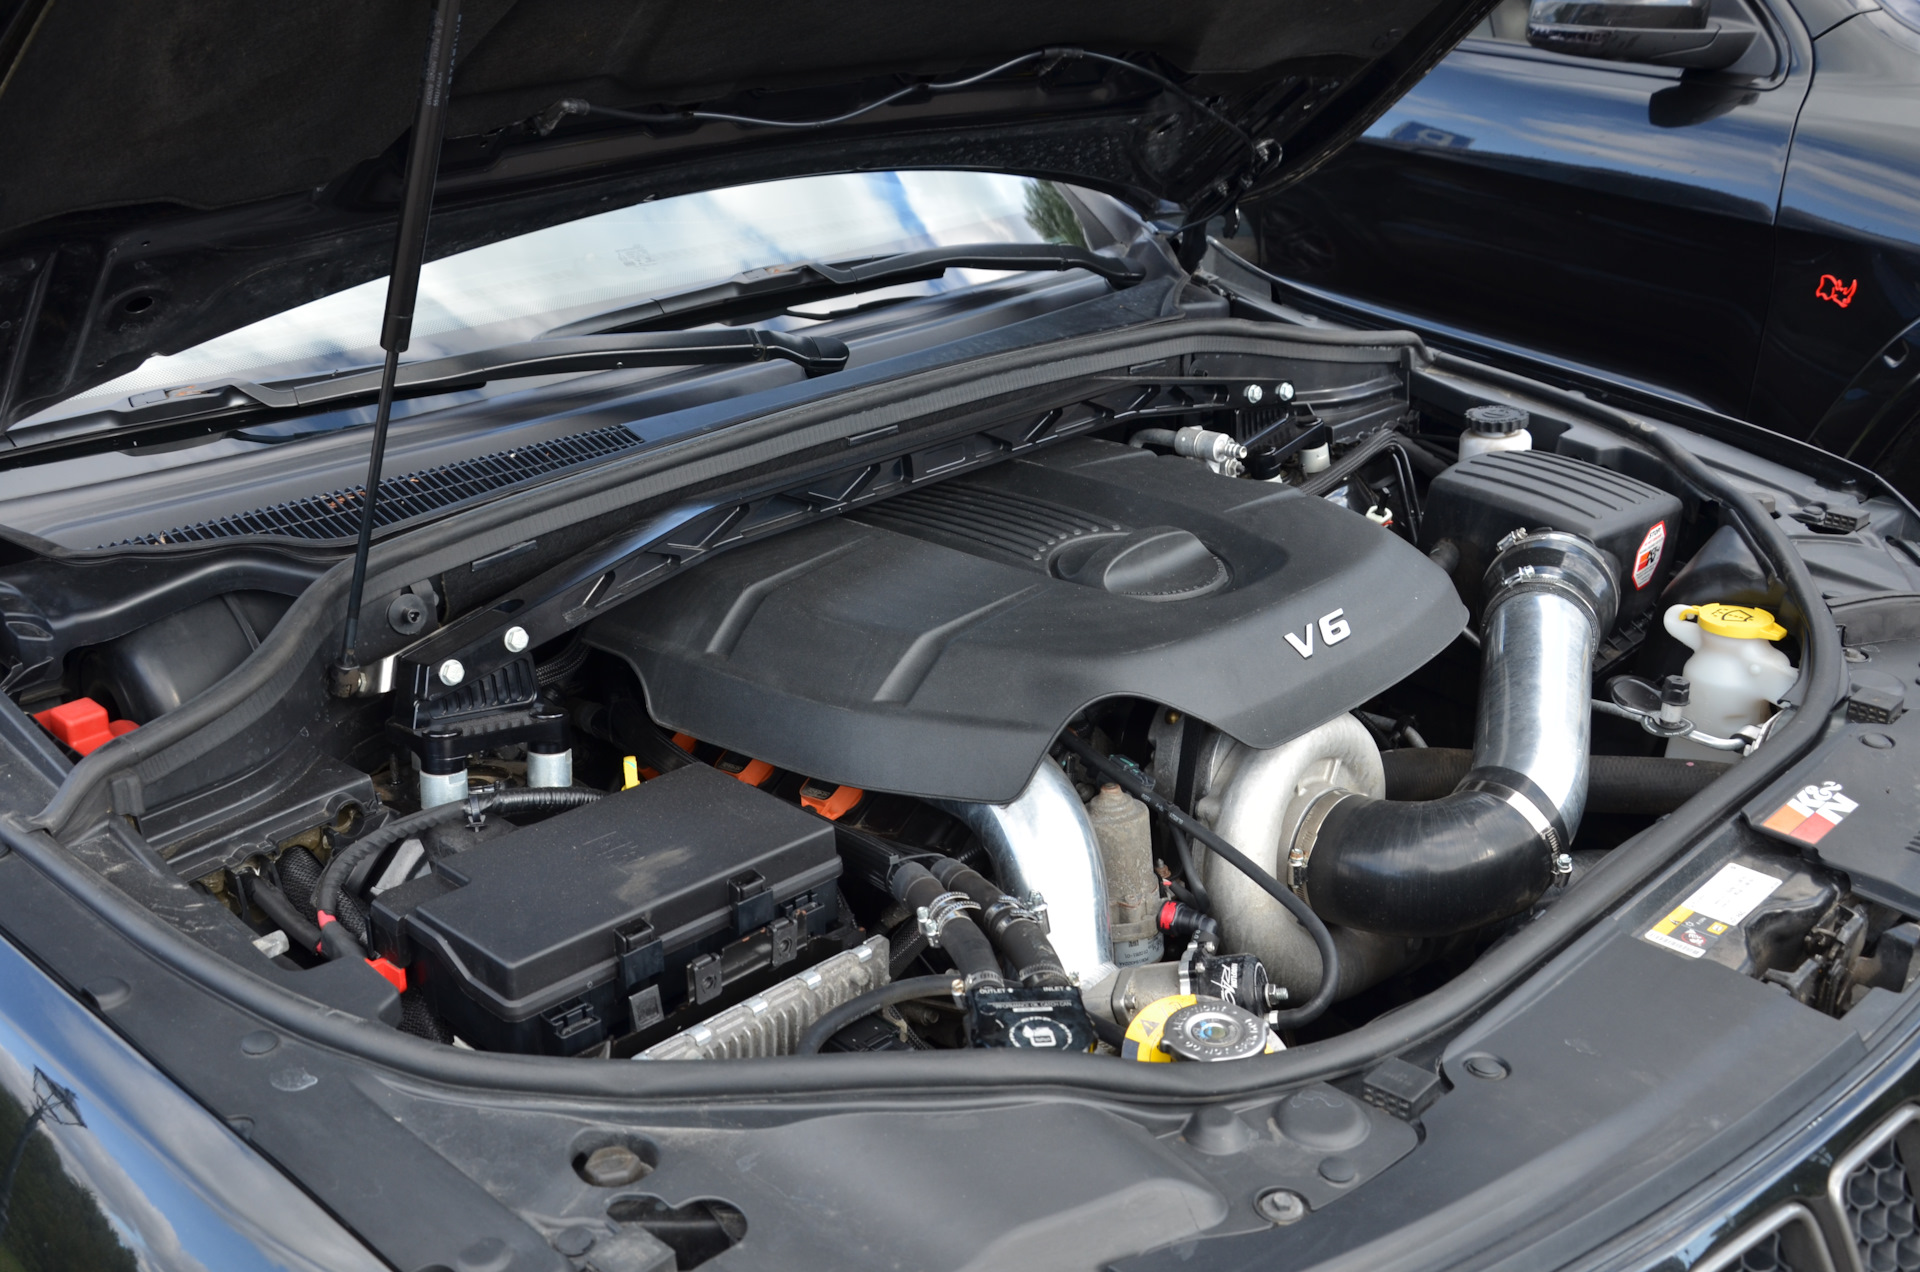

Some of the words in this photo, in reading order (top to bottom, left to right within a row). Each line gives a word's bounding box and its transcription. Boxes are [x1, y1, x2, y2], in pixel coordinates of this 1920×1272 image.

[1283, 607, 1351, 660] V6
[1786, 781, 1859, 825] K&N
[1210, 964, 1236, 1005] RAC
